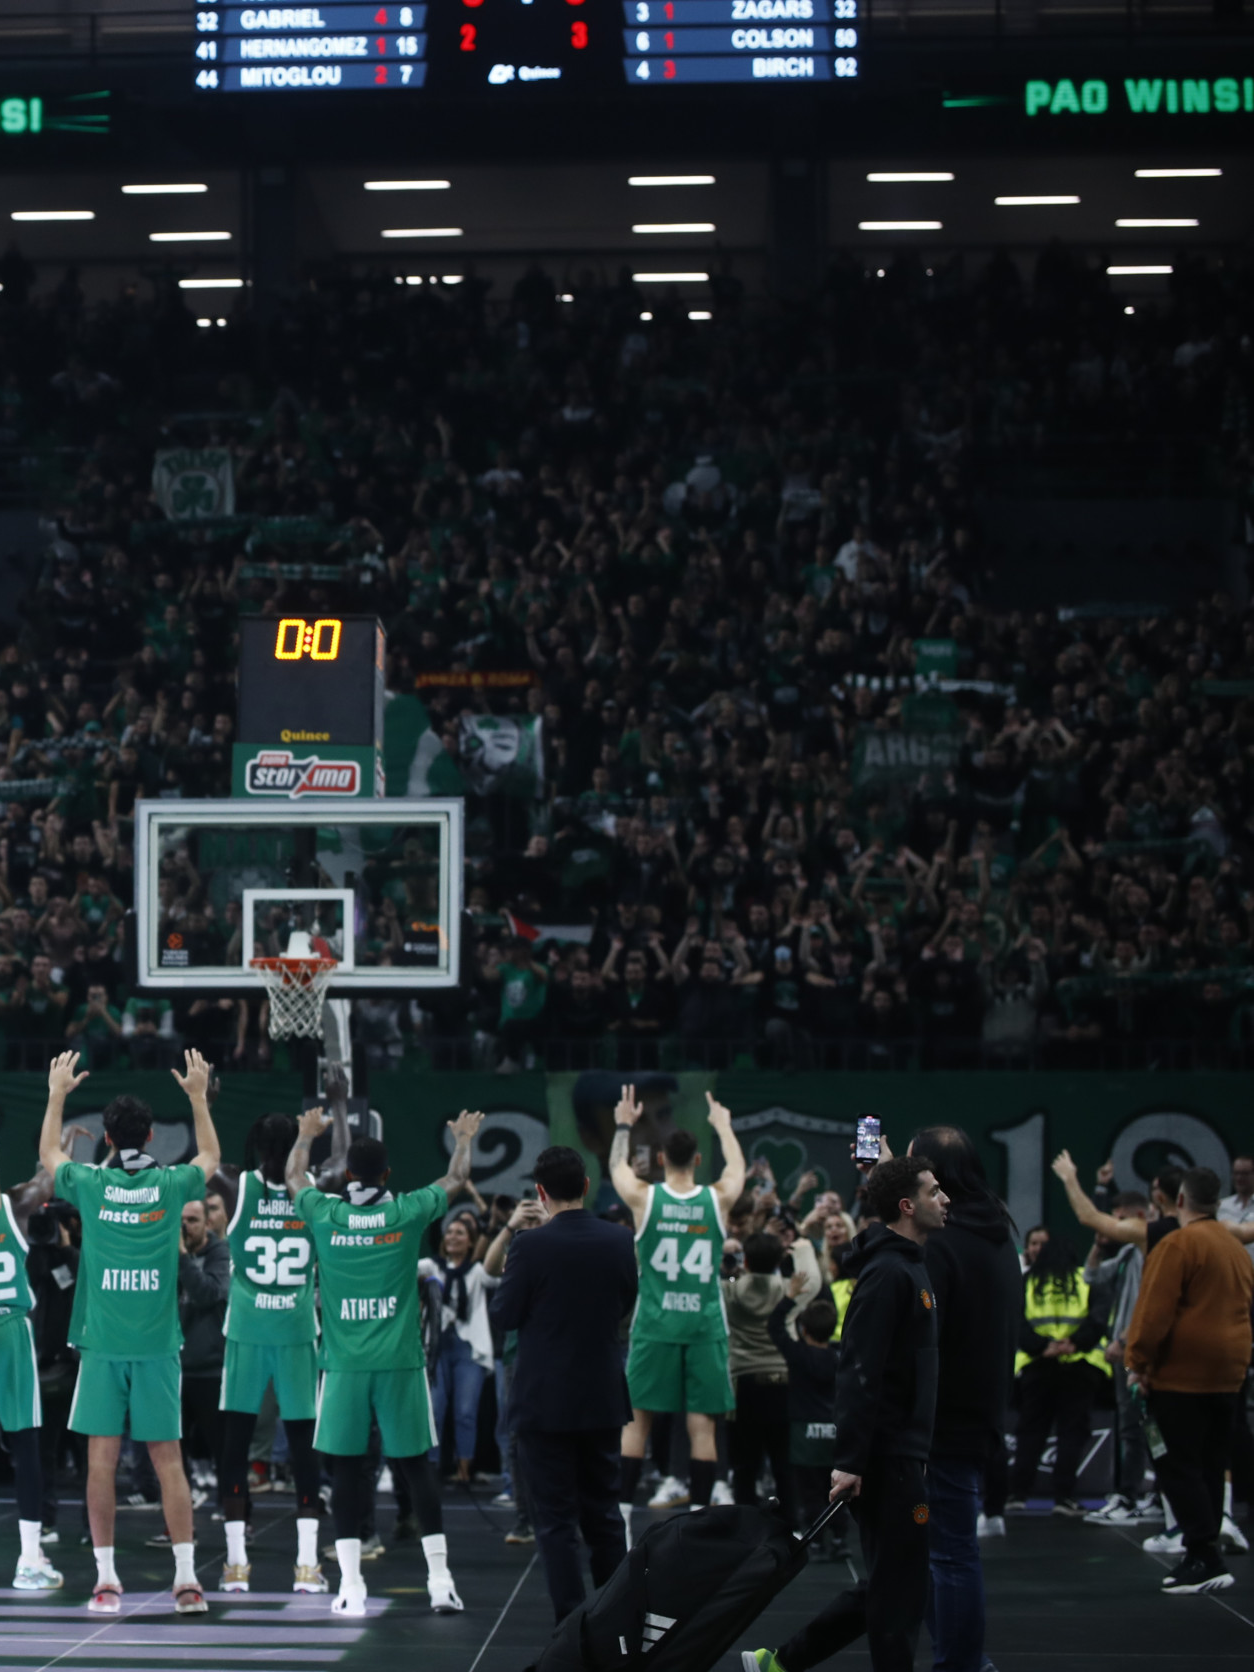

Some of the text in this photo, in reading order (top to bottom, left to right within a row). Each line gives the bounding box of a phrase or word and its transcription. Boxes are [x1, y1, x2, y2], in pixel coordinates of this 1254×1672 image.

[197, 7, 413, 31] 32 GABRIEL 4 8
[636, 2, 650, 22] 3
[664, 2, 674, 20] 1
[731, 0, 814, 19] ZAGARS
[460, 21, 588, 51] 2 3
[664, 31, 674, 49] 1
[731, 28, 814, 49] COLSON
[196, 40, 217, 60] 41
[240, 36, 368, 58] HERNANGOMEZ
[375, 37, 386, 55] 1
[196, 65, 413, 88] 44 MITOGLOU 2 7
[636, 60, 650, 80] 4
[663, 60, 676, 79] 3
[752, 57, 814, 78] BIRCH
[1025, 80, 1108, 116] PAO
[280, 729, 330, 743] Quince
[98, 1205, 166, 1224] instacar
[258, 1199, 296, 1216] GABRIE
[250, 1216, 305, 1230] instacar
[348, 1212, 386, 1230] BROWN
[330, 1230, 403, 1247] instacar
[244, 1236, 311, 1286] 32
[649, 1237, 714, 1284] 44
[101, 1268, 160, 1291] ATHENS
[340, 1296, 397, 1320] ATHENS
[662, 1291, 701, 1312] ATHENS
